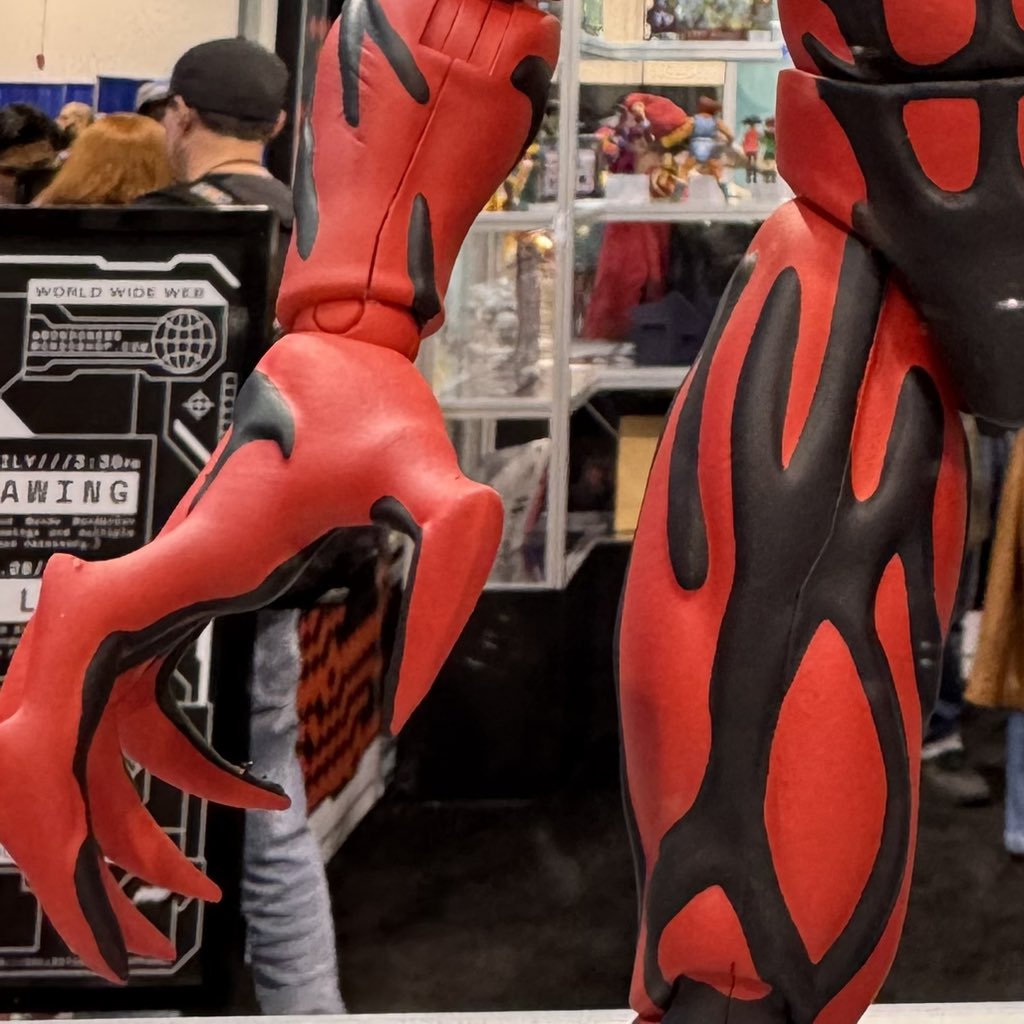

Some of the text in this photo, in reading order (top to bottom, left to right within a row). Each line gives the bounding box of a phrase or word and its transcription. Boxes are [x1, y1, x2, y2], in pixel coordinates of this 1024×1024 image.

[35, 286, 205, 299] WORLD WIDE WEB
[0, 479, 129, 504] AWING
